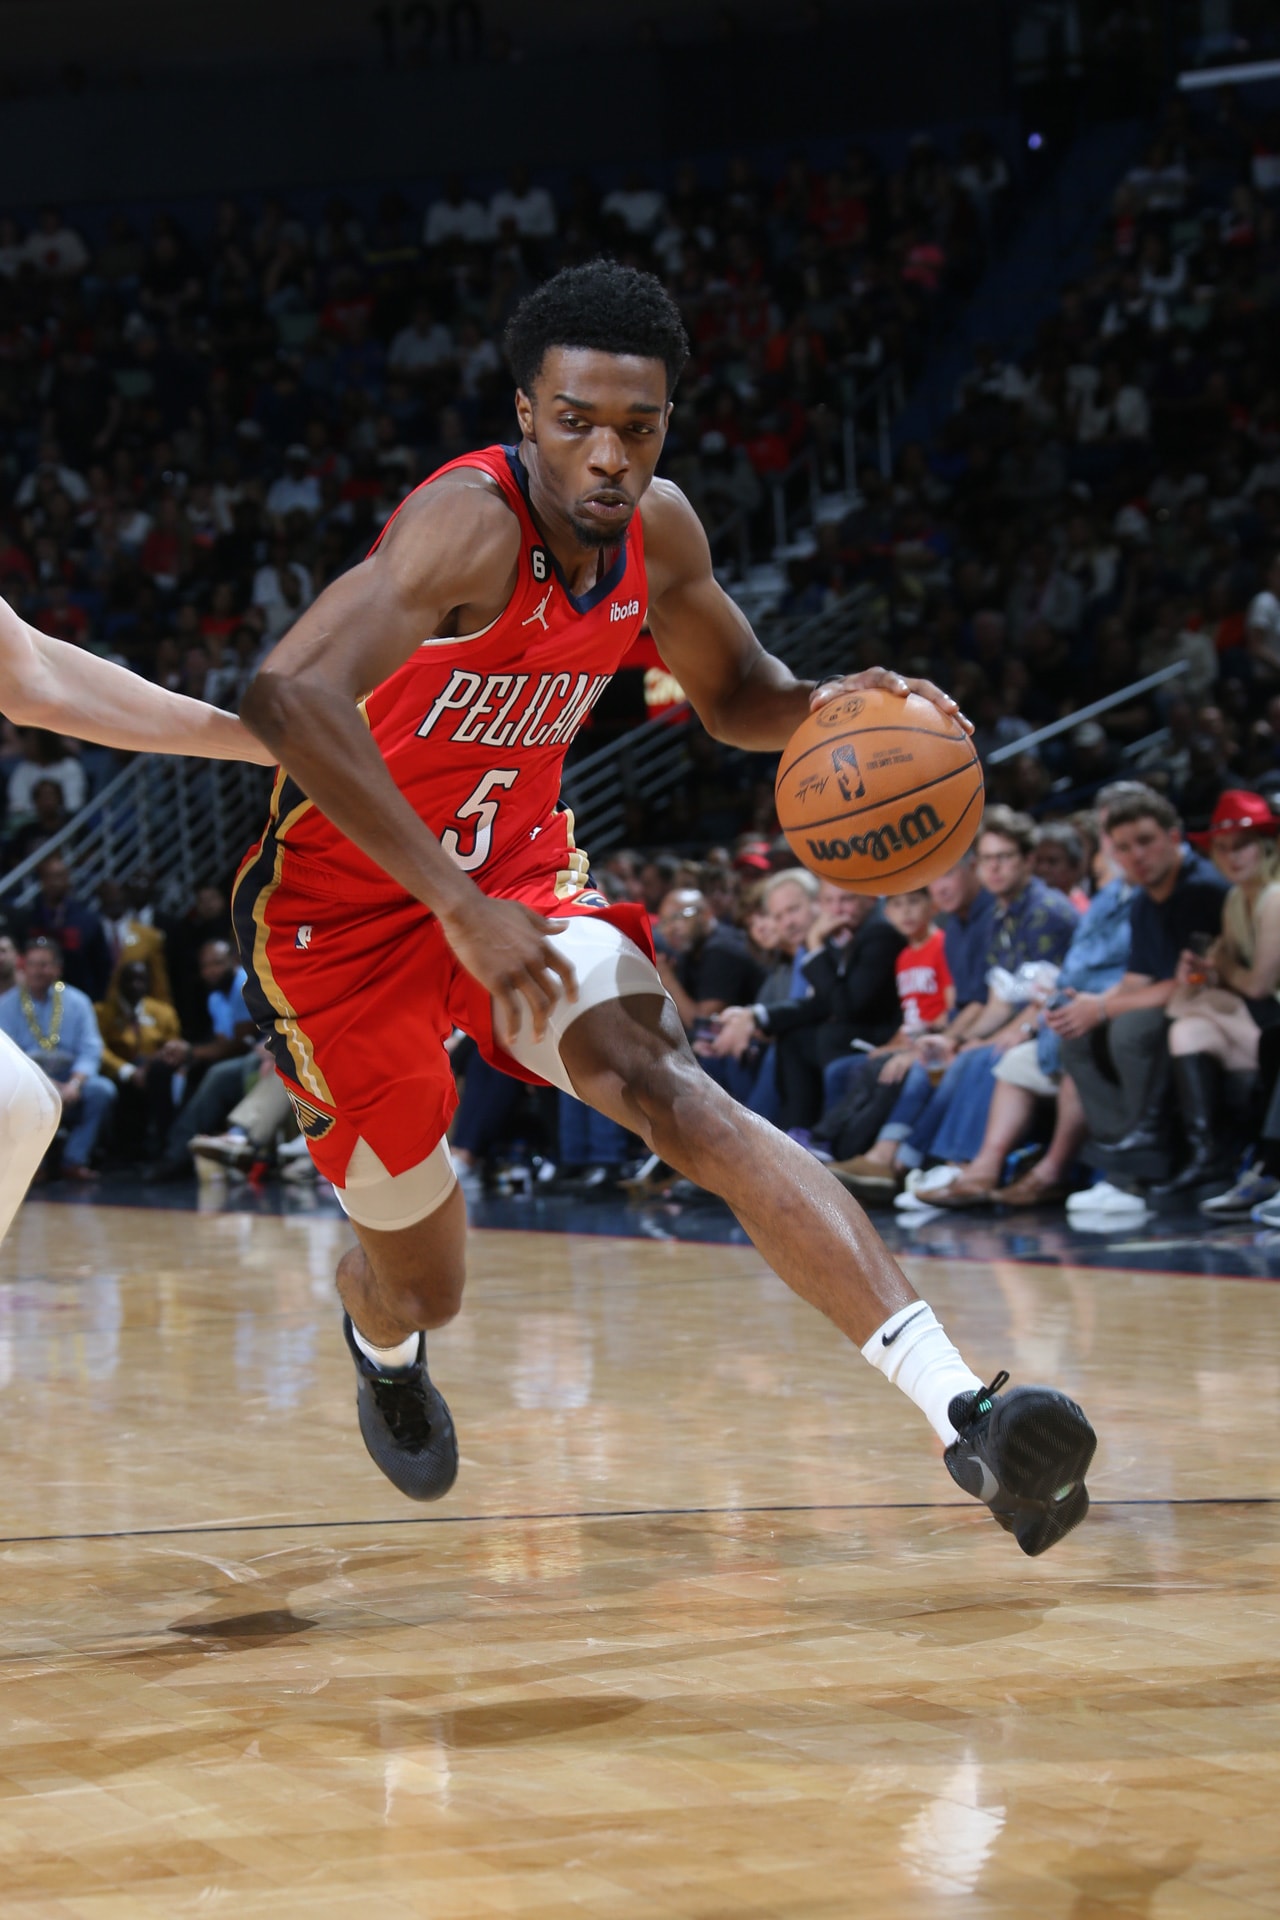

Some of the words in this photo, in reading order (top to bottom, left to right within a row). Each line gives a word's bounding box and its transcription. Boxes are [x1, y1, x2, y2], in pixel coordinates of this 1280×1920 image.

[533, 550, 546, 579] 6
[610, 600, 640, 622] ibota
[440, 768, 520, 872] 5
[806, 803, 946, 862] Wilson
